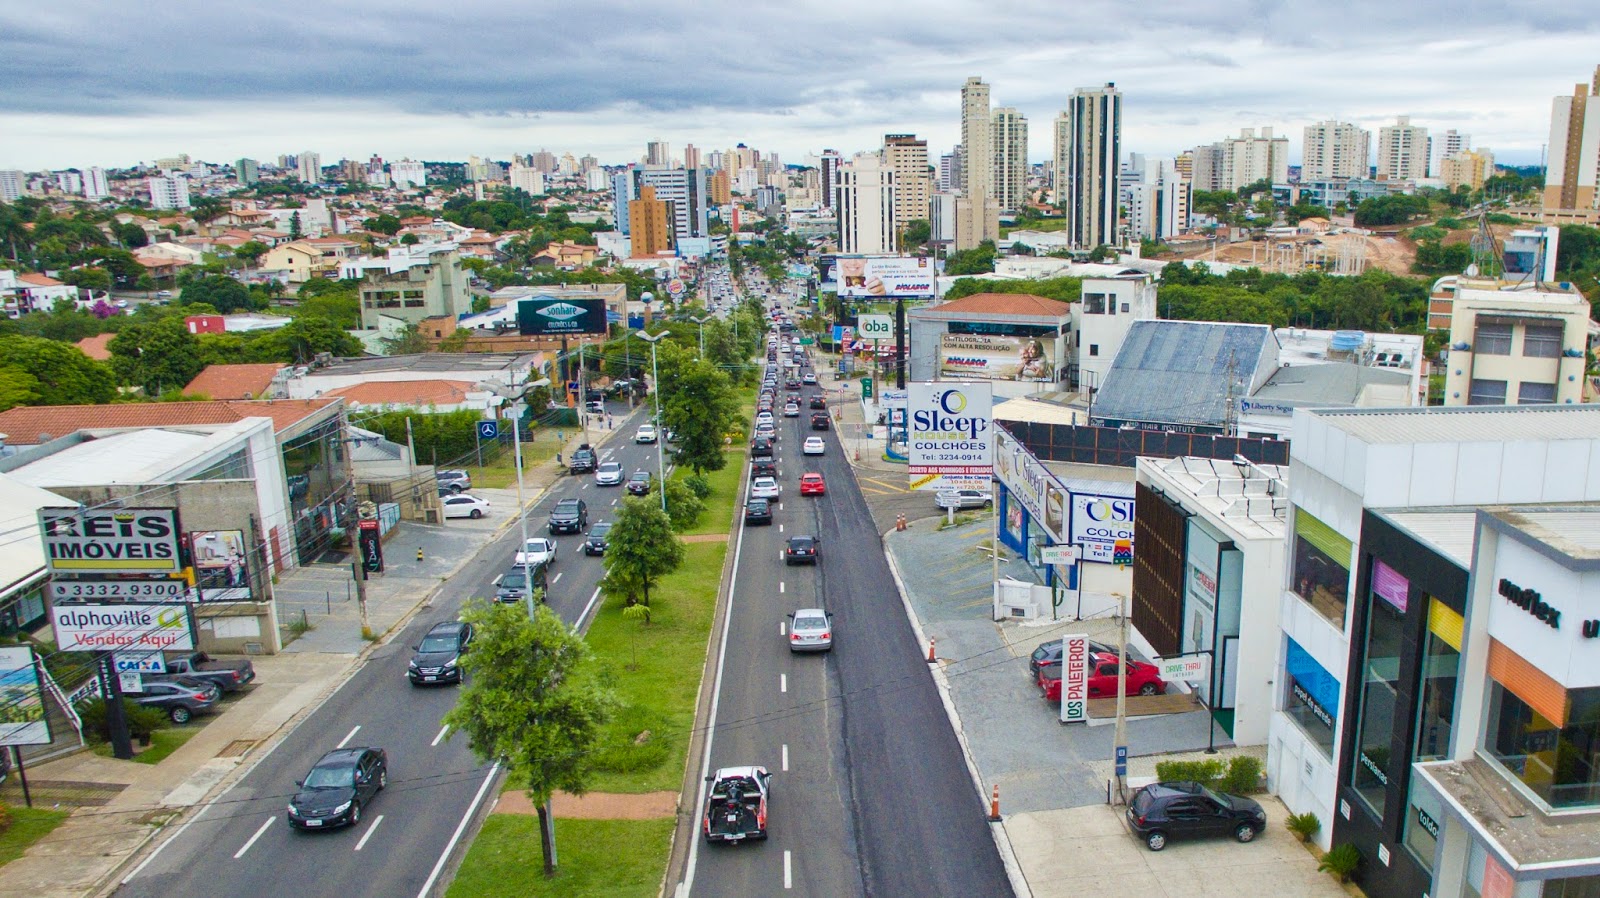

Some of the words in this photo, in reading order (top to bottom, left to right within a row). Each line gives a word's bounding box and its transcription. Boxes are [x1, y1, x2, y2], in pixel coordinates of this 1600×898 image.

[547, 302, 577, 315] sonhare
[865, 320, 889, 332] oba
[1251, 402, 1274, 413] Liberty
[914, 410, 987, 440] Sleep
[914, 432, 968, 440] HOUSE
[915, 441, 986, 450] COLCHÕES
[909, 466, 927, 474] ABERTO
[939, 466, 965, 474] DOMINGOS
[970, 466, 992, 474] FERIADOS
[44, 514, 171, 538] REIS
[49, 540, 172, 558] IMÓVEIS
[73, 585, 178, 595] 3332.9300
[60, 611, 151, 629] alphaville
[75, 633, 133, 645] Vendas
[139, 632, 177, 648] Aqui
[118, 661, 161, 670] CAIXA
[1068, 638, 1084, 700] PALETEROS
[1165, 662, 1202, 673] DRIVE-THRU
[1067, 701, 1083, 719] LOS
[1360, 752, 1388, 785] persianas
[1420, 811, 1439, 837] toldo
